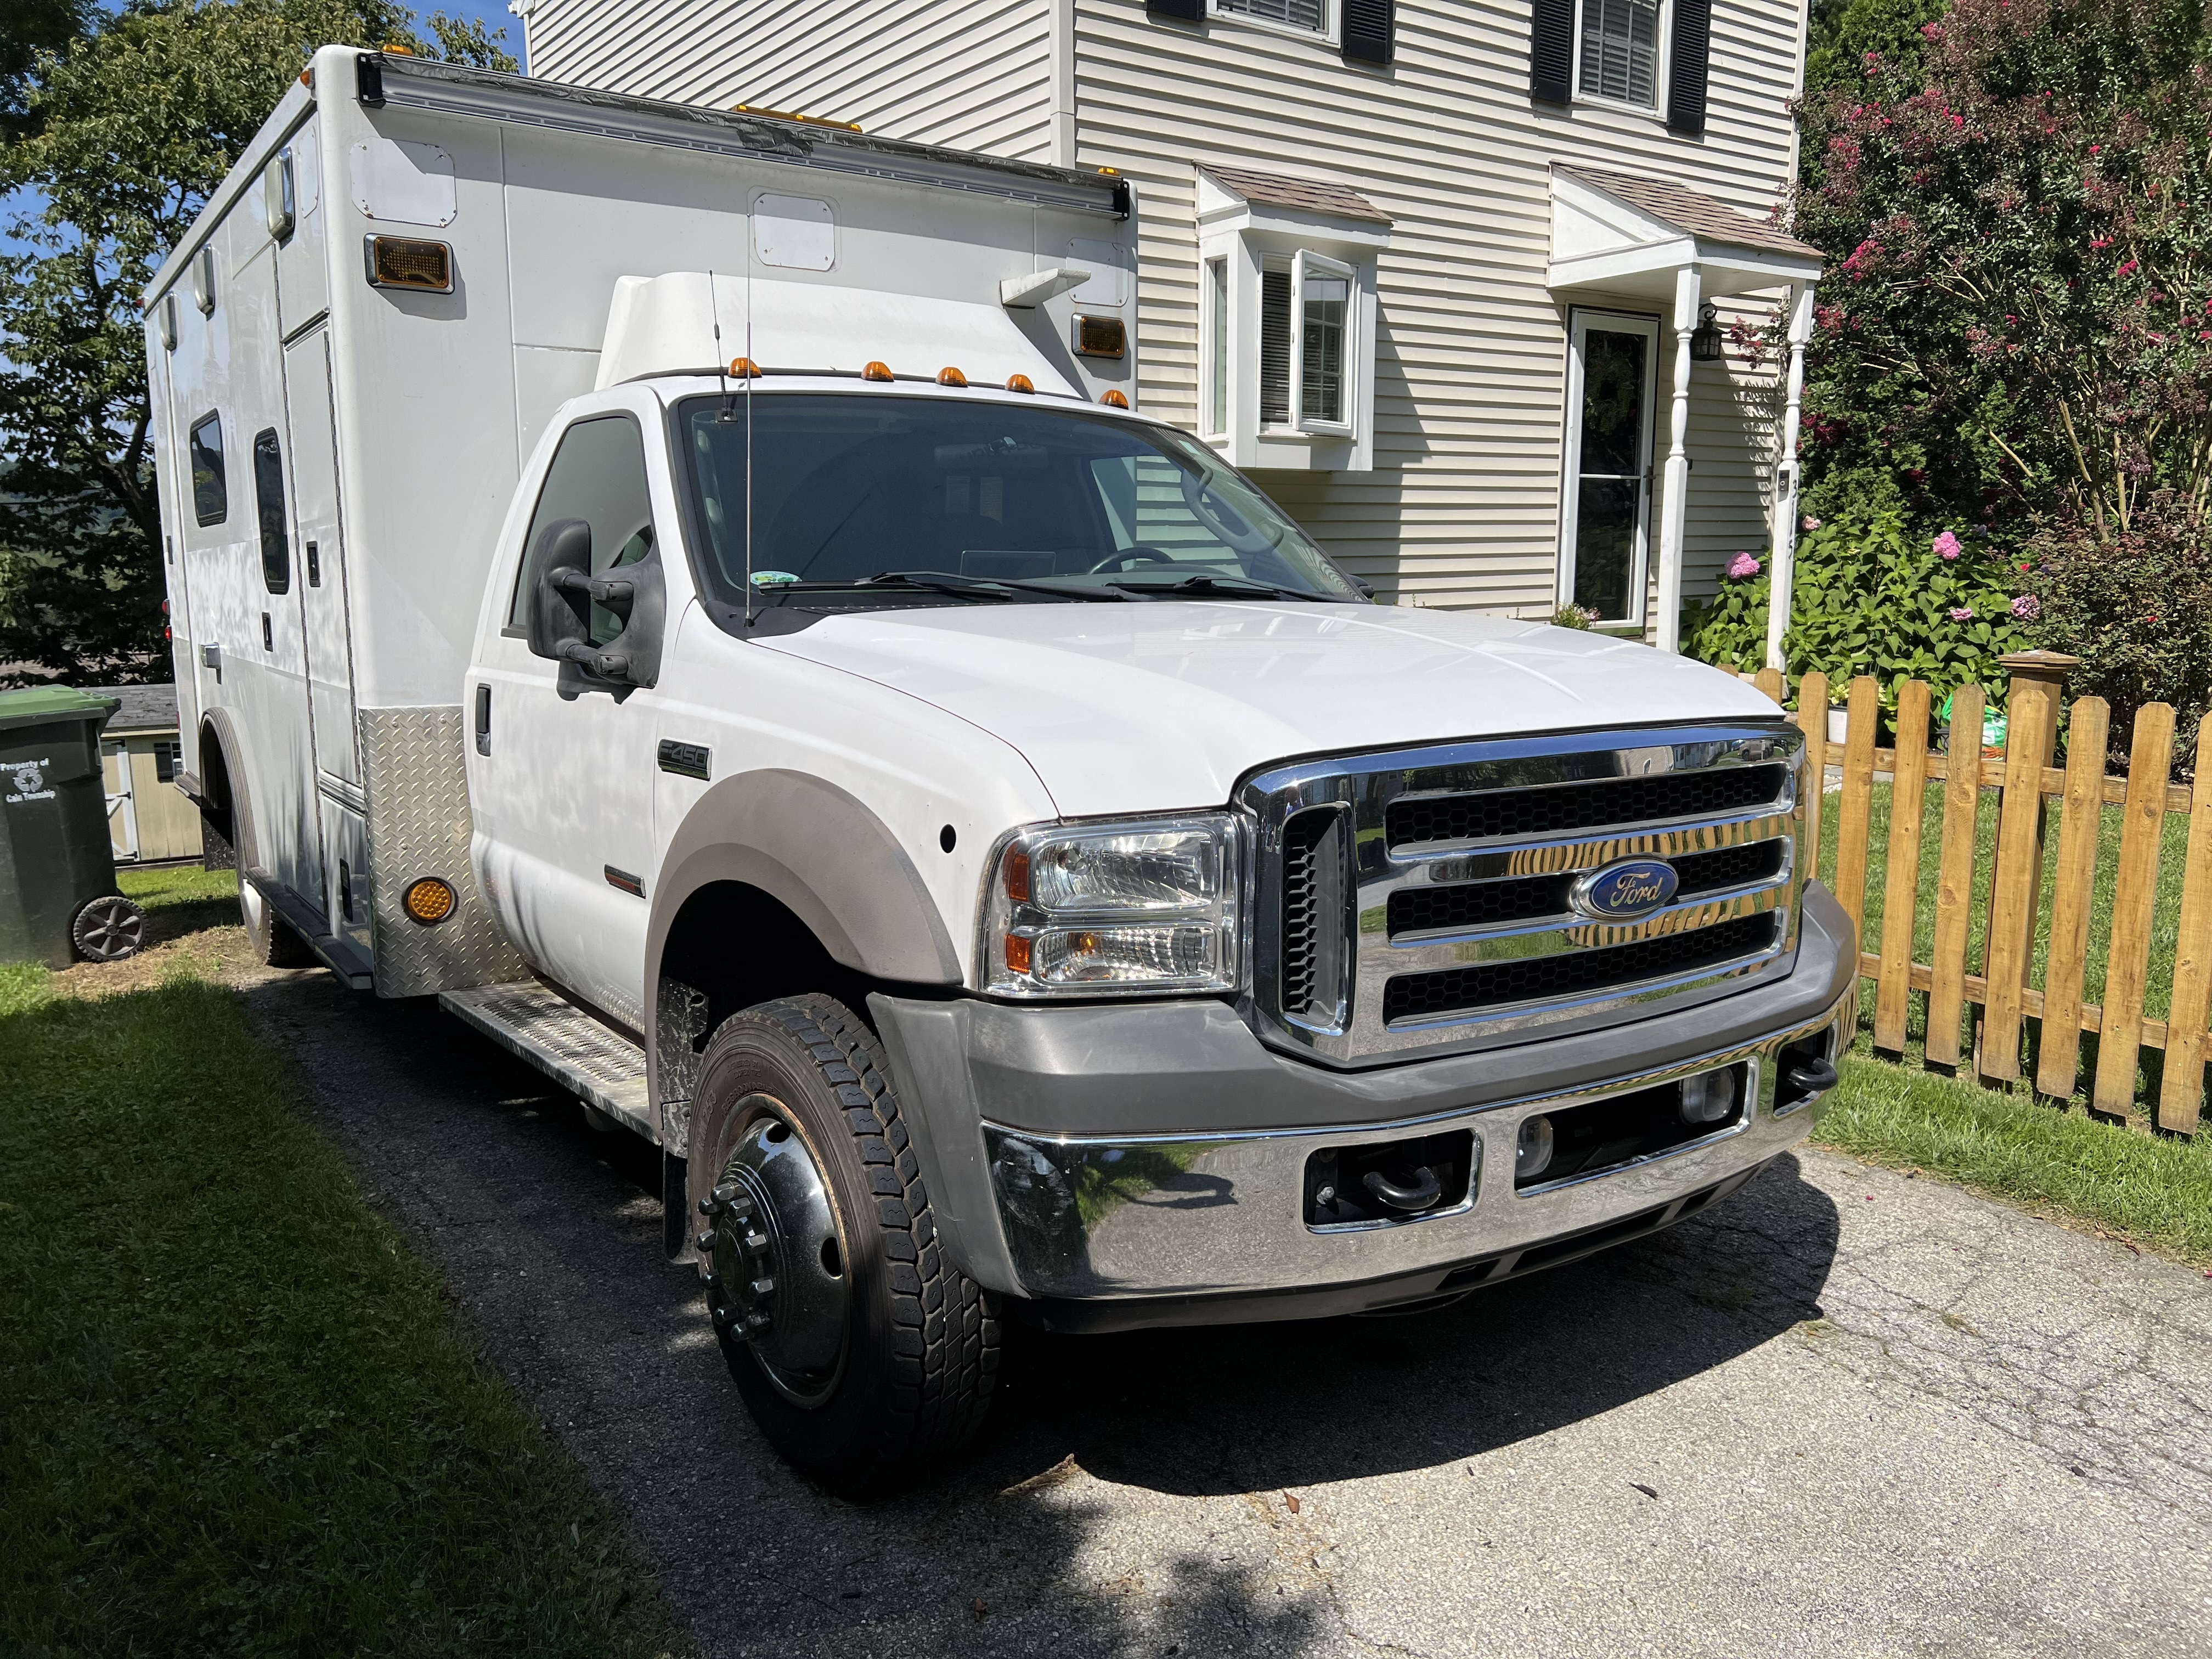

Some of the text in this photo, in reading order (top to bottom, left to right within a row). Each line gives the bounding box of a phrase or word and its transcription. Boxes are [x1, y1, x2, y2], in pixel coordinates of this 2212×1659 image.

[1788, 479, 1797, 560] 3115
[0, 758, 49, 771] Property of
[658, 742, 708, 768] F-450
[22, 789, 55, 800] Township
[1610, 872, 1663, 907] Ford
